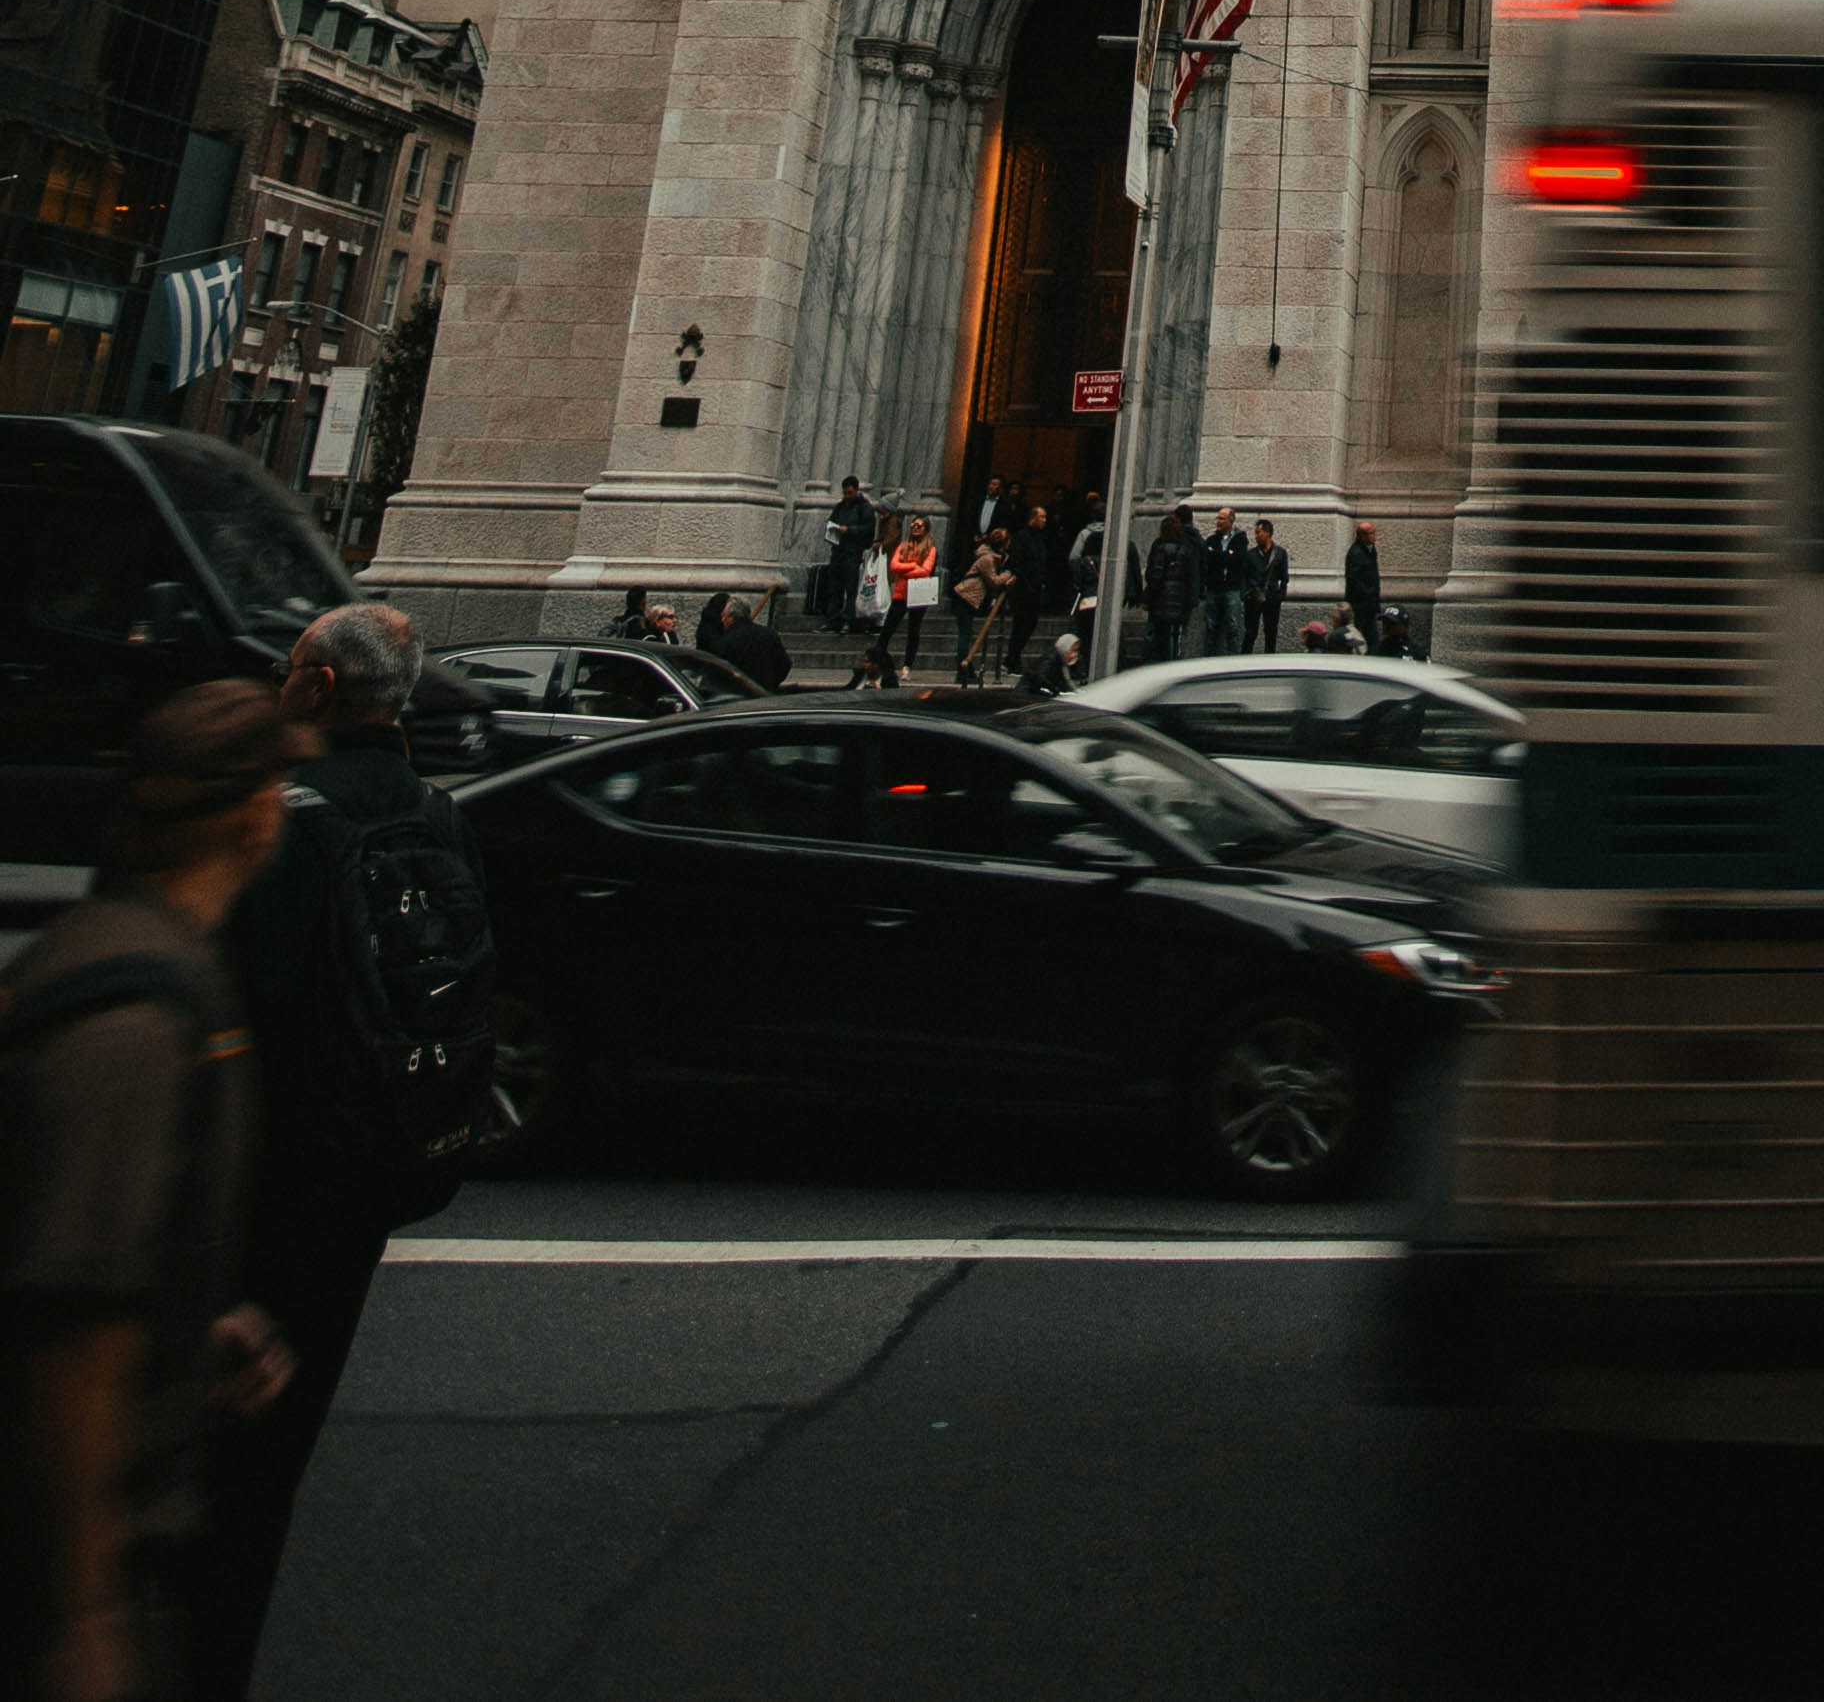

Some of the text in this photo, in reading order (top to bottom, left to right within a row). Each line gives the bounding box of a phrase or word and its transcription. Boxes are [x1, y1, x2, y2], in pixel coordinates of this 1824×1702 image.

[1079, 374, 1120, 384] NO STANDING
[1082, 385, 1114, 395] ANYTIME
